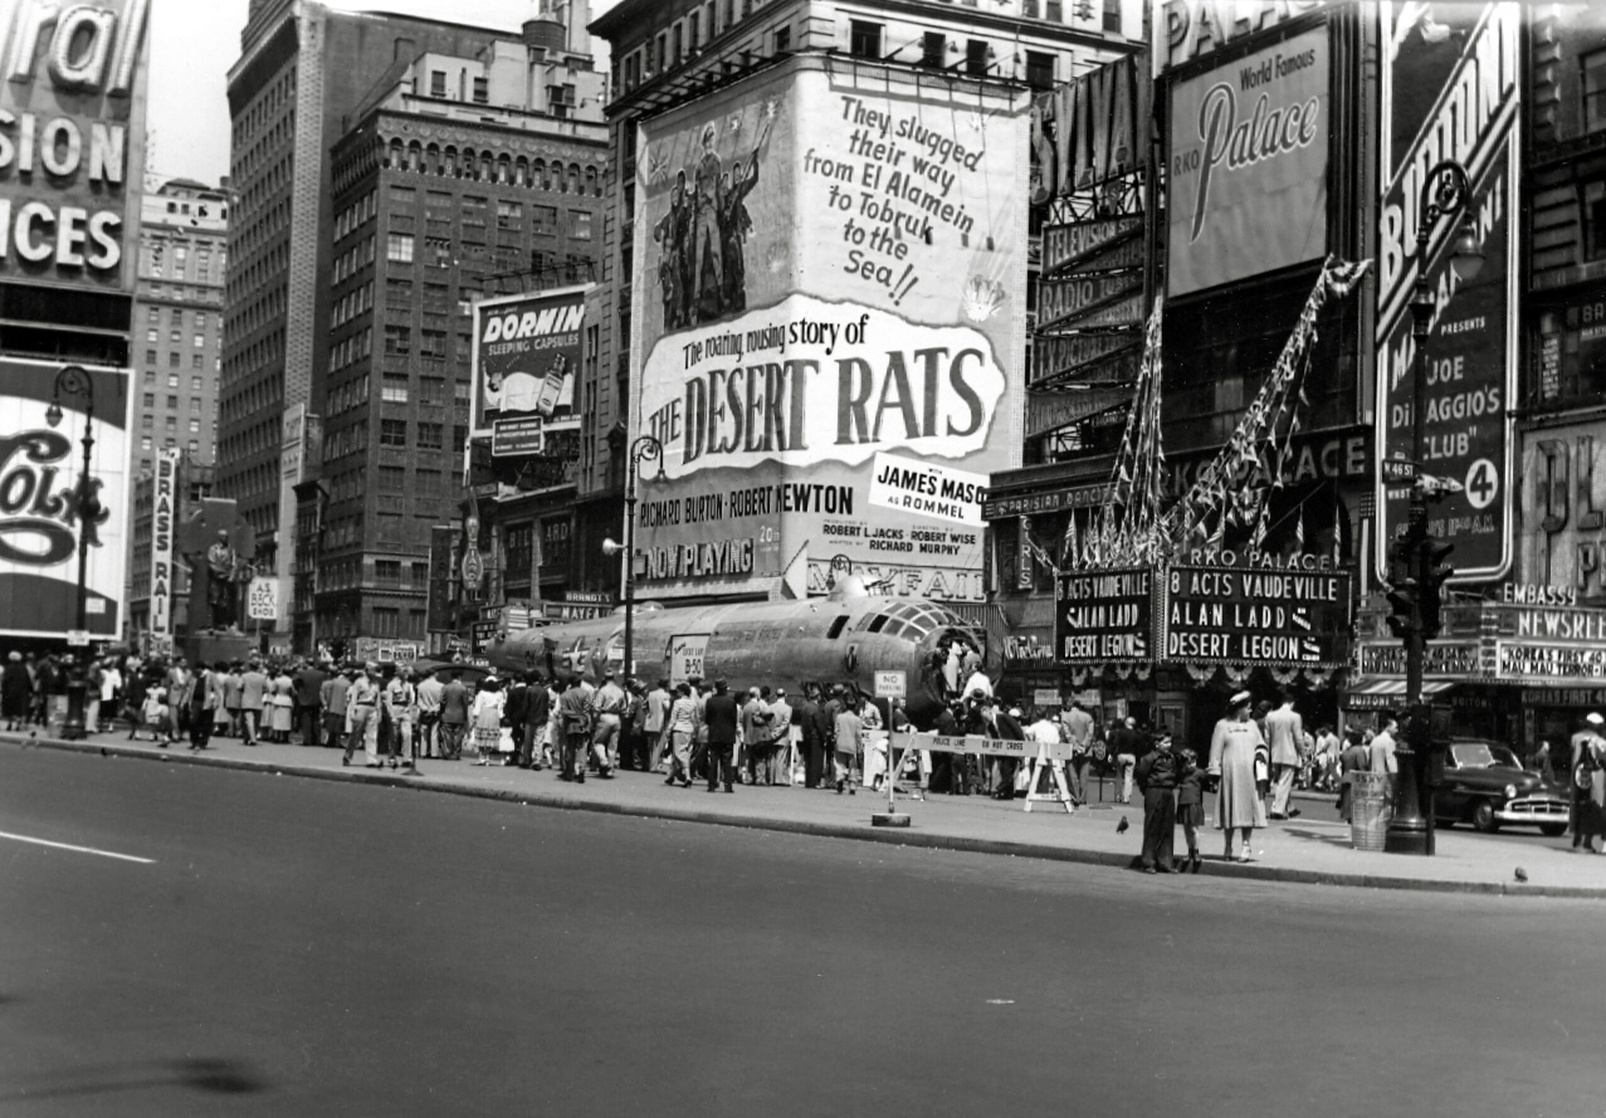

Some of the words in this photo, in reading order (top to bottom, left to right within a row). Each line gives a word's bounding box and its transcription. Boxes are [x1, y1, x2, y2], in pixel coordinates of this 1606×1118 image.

[1240, 58, 1273, 91] World
[1274, 49, 1316, 79] Famous
[841, 96, 891, 138] They
[896, 116, 985, 172] slugged
[849, 129, 907, 167] their
[913, 154, 955, 197] way
[1174, 149, 1200, 177] RKO
[1190, 81, 1319, 245] Palace
[804, 148, 855, 183] from
[861, 163, 882, 190] El
[885, 171, 975, 234] Alamein
[828, 185, 851, 211] to
[859, 192, 933, 239] Tobruk
[843, 218, 866, 245] to
[871, 226, 909, 260] the
[1047, 221, 1117, 268] TELEVISION
[843, 249, 919, 306] Sea!!
[1042, 280, 1094, 323] RADIO
[482, 304, 584, 343] DORMIN
[1441, 316, 1485, 336] PRESENTS
[488, 341, 530, 356] SLEEPING
[534, 333, 580, 350] CAPSULES
[683, 340, 703, 370] The
[746, 323, 785, 354] rousing
[788, 319, 840, 355] story
[845, 314, 870, 345] of
[649, 397, 682, 448] THE
[682, 358, 820, 466] DESERT
[832, 347, 986, 445] RATS
[1392, 383, 1500, 428] DiAGGIO'S
[878, 465, 937, 496] JAMES
[1392, 463, 1403, 476] 46
[1404, 465, 1414, 476] ST
[1470, 463, 1493, 502] 4
[157, 460, 172, 551] BRASS
[640, 499, 681, 528] RICHARD
[685, 493, 723, 523] BURTON
[729, 485, 773, 518] ROBERT
[775, 484, 854, 516] NEWTON
[903, 495, 964, 519] ROMMEL
[823, 524, 862, 538] ROBERT
[911, 530, 947, 543] ROBERT
[950, 533, 976, 545] WISE
[869, 539, 913, 553] RICHARD
[919, 544, 960, 556] MURPHY
[647, 545, 679, 579] NOW
[683, 538, 753, 577] PLAYING
[1191, 550, 1237, 567] RKO
[1250, 552, 1330, 570] PALACE
[153, 562, 168, 632] RAIL
[1067, 577, 1091, 600] ACTS
[1093, 573, 1148, 598] VAUDEVILLE
[1170, 571, 1180, 594] 8
[1190, 572, 1232, 596] ACTS
[1242, 574, 1338, 601] VAUDEVILLE
[1504, 582, 1577, 606] EMBASSY
[1076, 605, 1105, 628] ALAN
[1109, 604, 1138, 627] LADD
[1171, 601, 1224, 626] ALAN
[1235, 604, 1286, 629] LADD
[1065, 635, 1098, 658] DESERT
[1101, 634, 1134, 658] LEGION
[1169, 632, 1230, 658] DESERT
[1242, 635, 1299, 660] LEGION
[883, 675, 898, 683] NO
[1503, 660, 1524, 674] MAU
[1531, 661, 1553, 675] MAU
[933, 737, 951, 746] POLICE
[954, 738, 966, 747] LINE
[982, 740, 989, 748] DO
[992, 741, 1003, 749] NOT
[1006, 742, 1023, 751] CROSS
